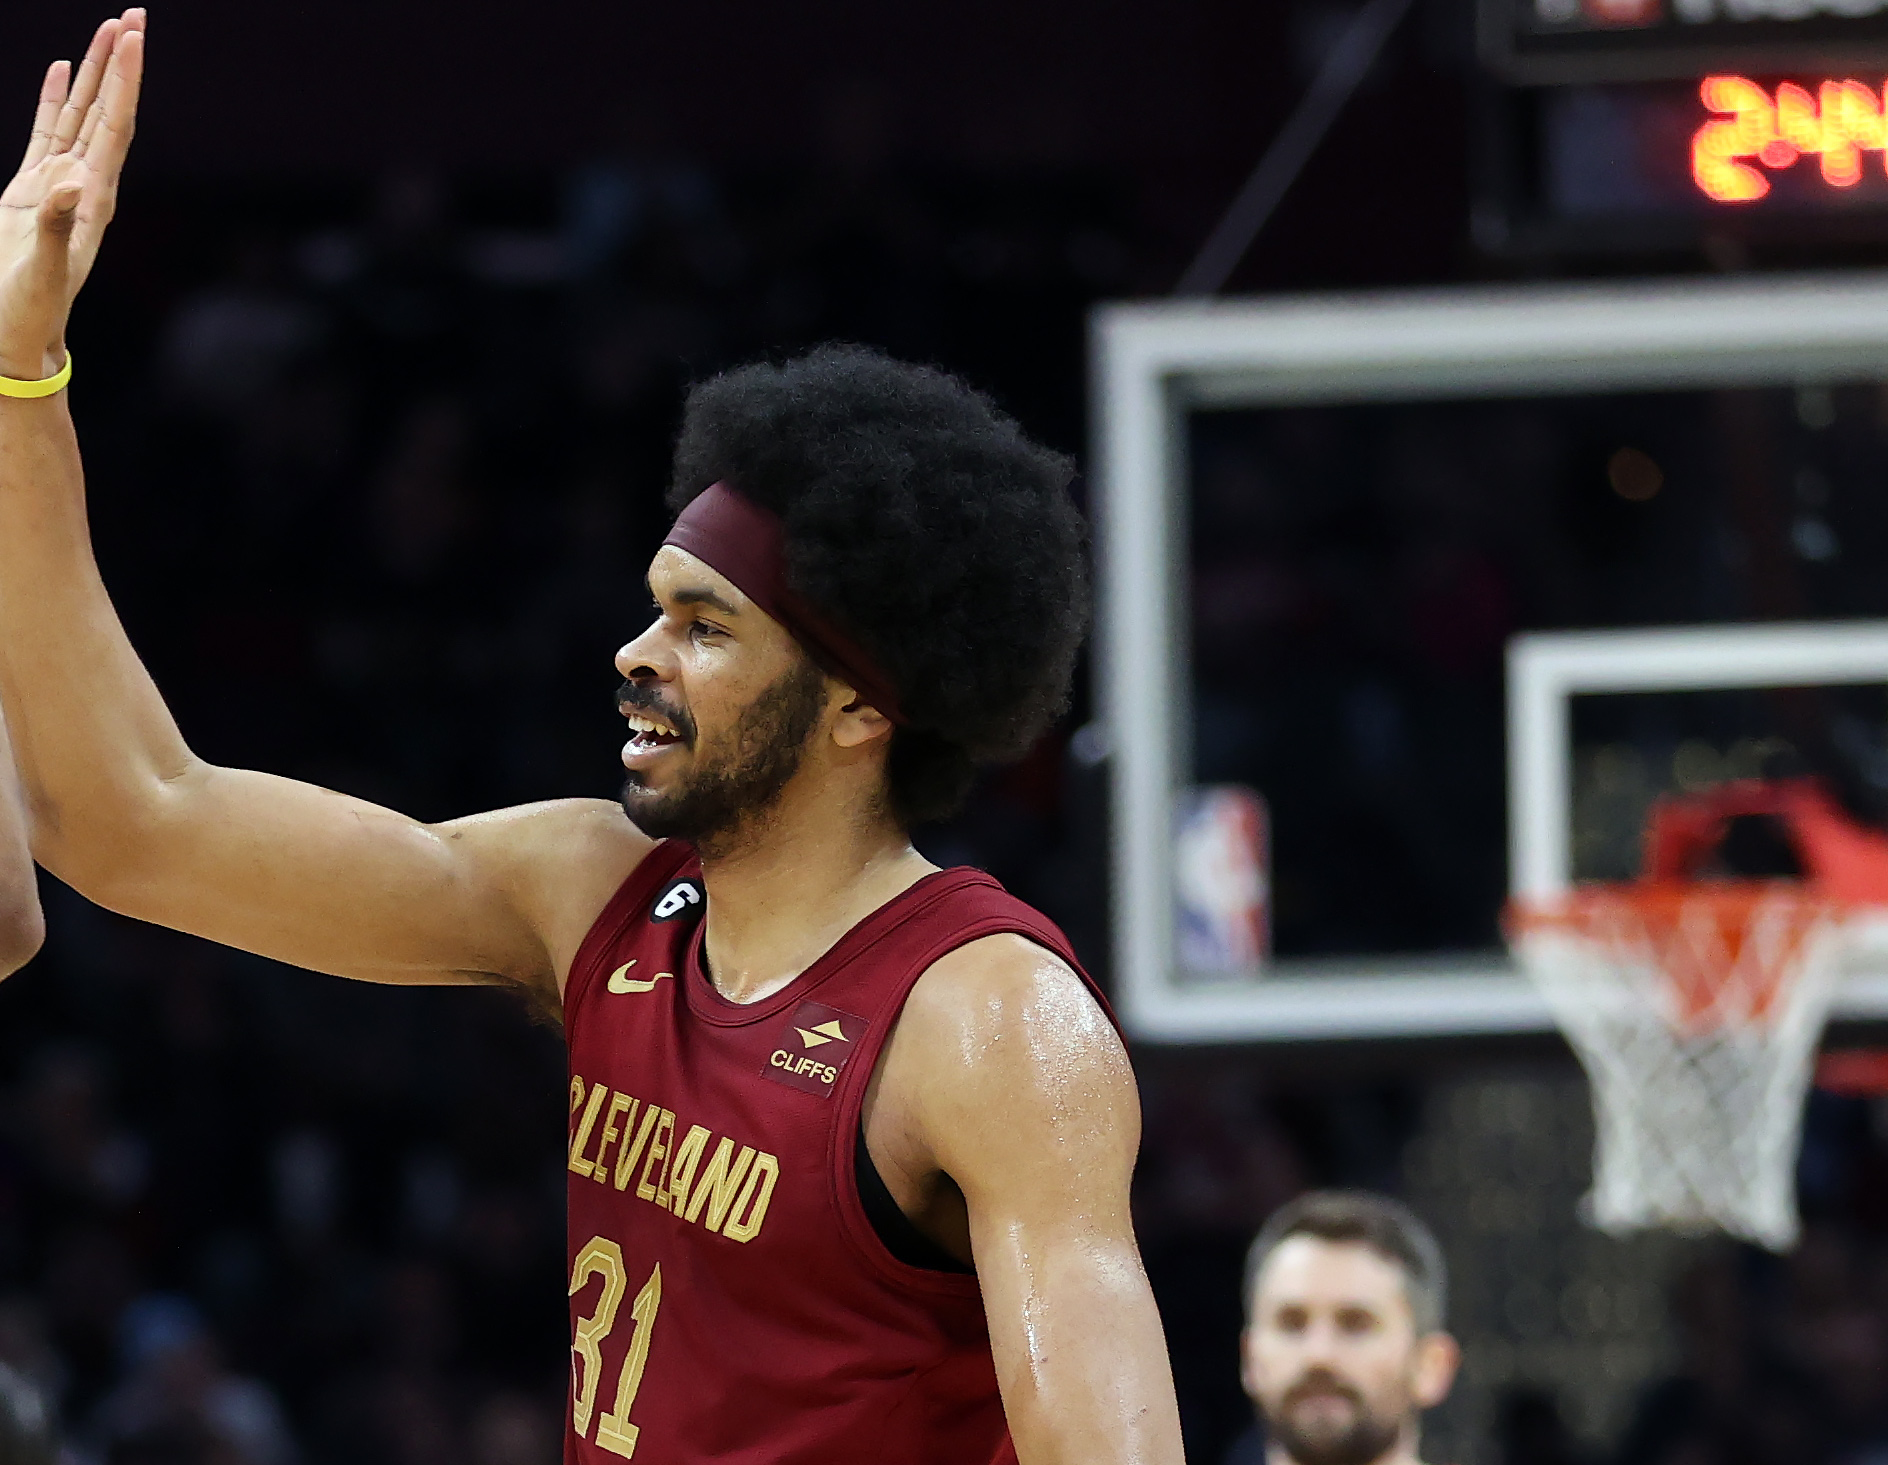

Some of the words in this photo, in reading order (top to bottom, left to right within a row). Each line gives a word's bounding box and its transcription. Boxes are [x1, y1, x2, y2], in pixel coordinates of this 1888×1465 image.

[654, 882, 700, 919] 6
[770, 1049, 837, 1084] CLIFFS
[568, 1235, 662, 1460] 31
